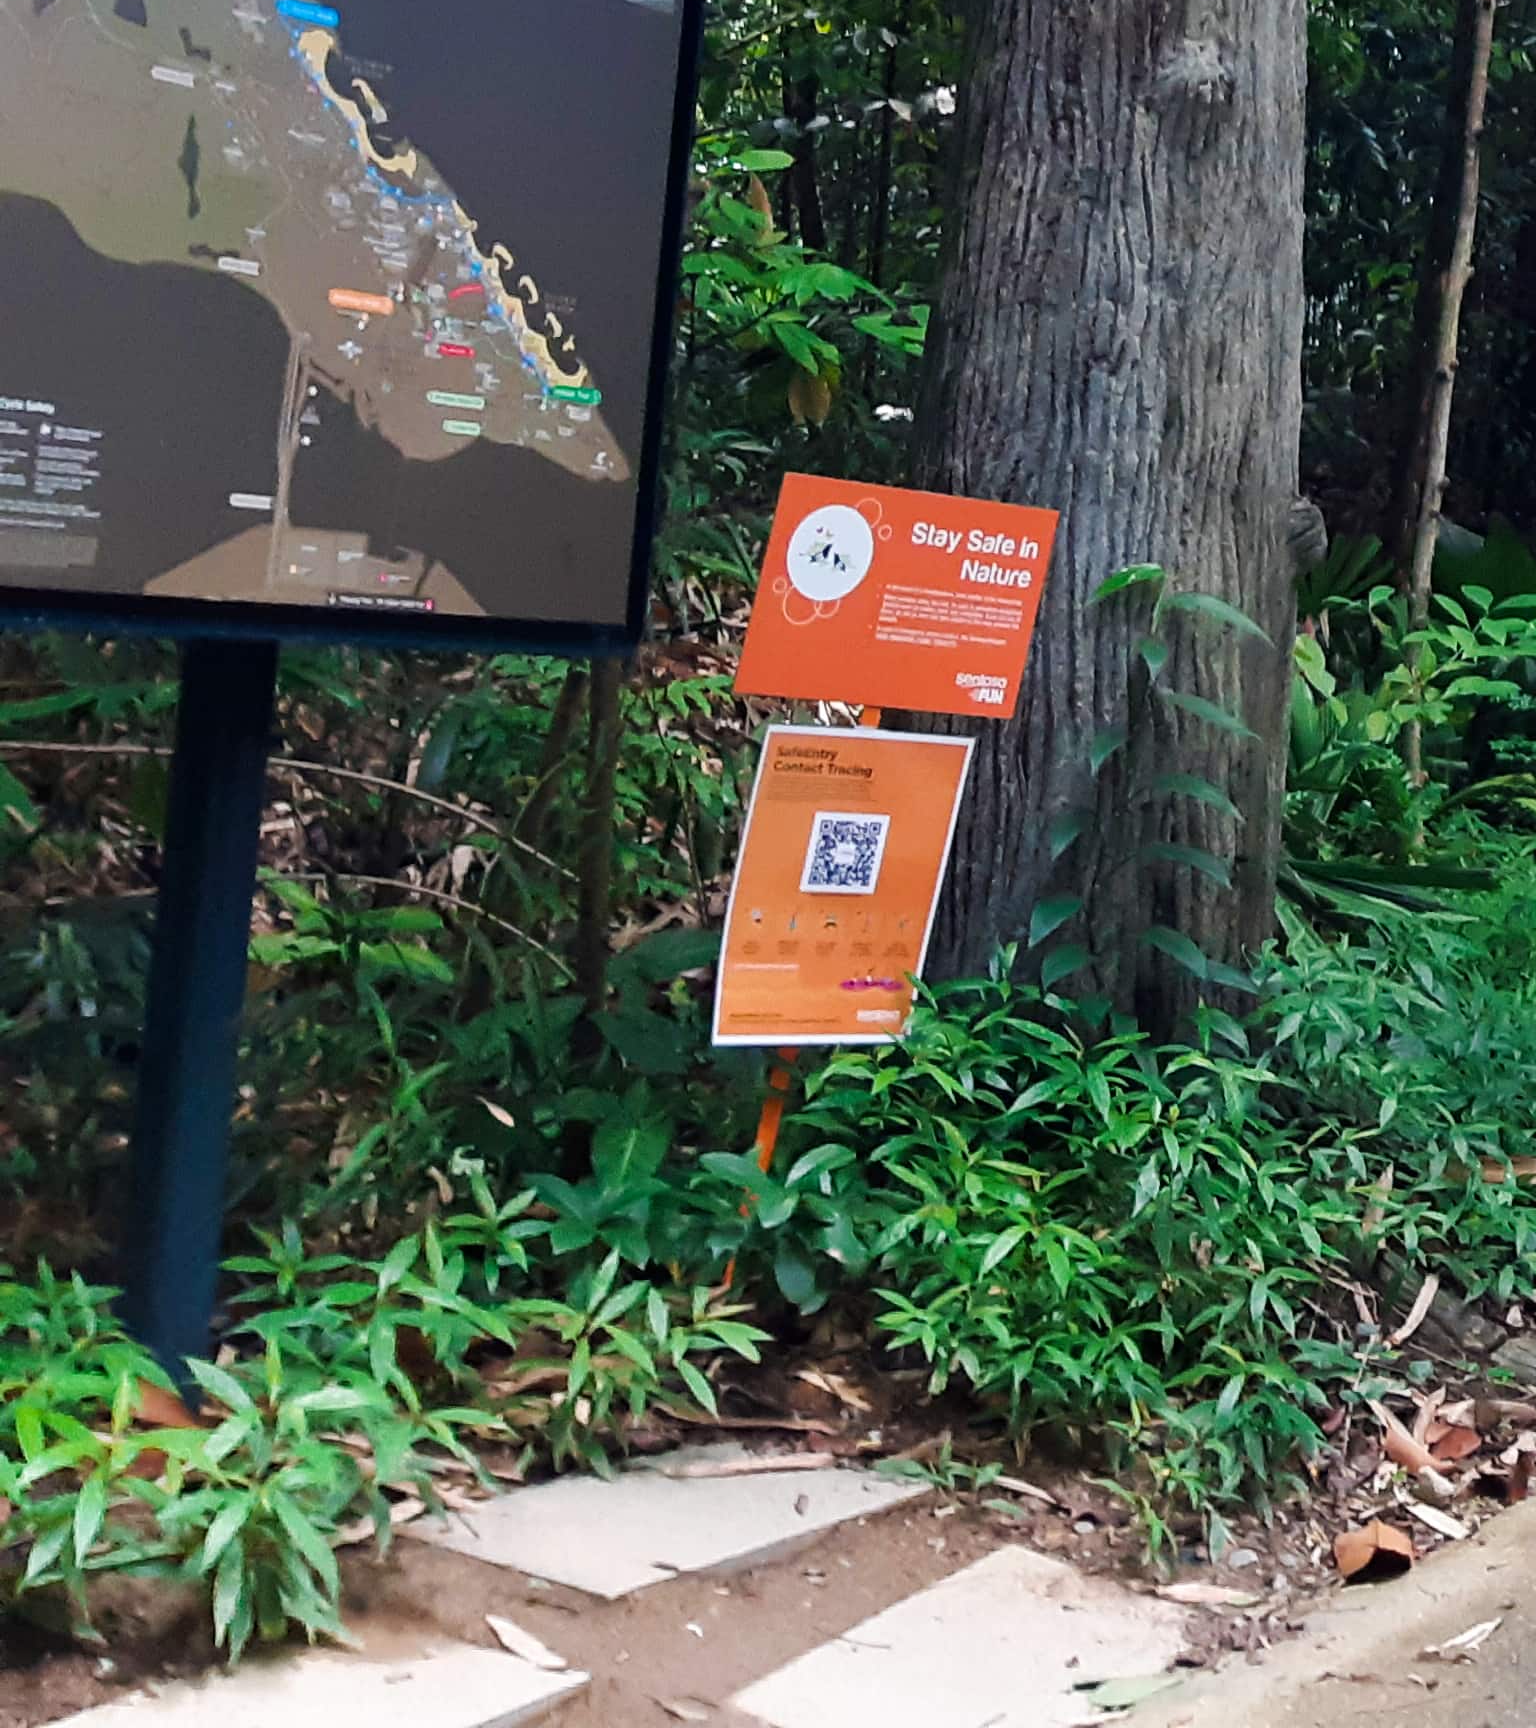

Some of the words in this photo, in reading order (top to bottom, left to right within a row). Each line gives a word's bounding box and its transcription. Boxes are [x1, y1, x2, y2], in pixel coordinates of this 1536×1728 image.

[911, 521, 963, 554] Stay
[967, 529, 1016, 556] Safe
[960, 559, 1033, 588] Nature
[773, 760, 824, 775] Contact
[828, 762, 873, 779] Tracing
